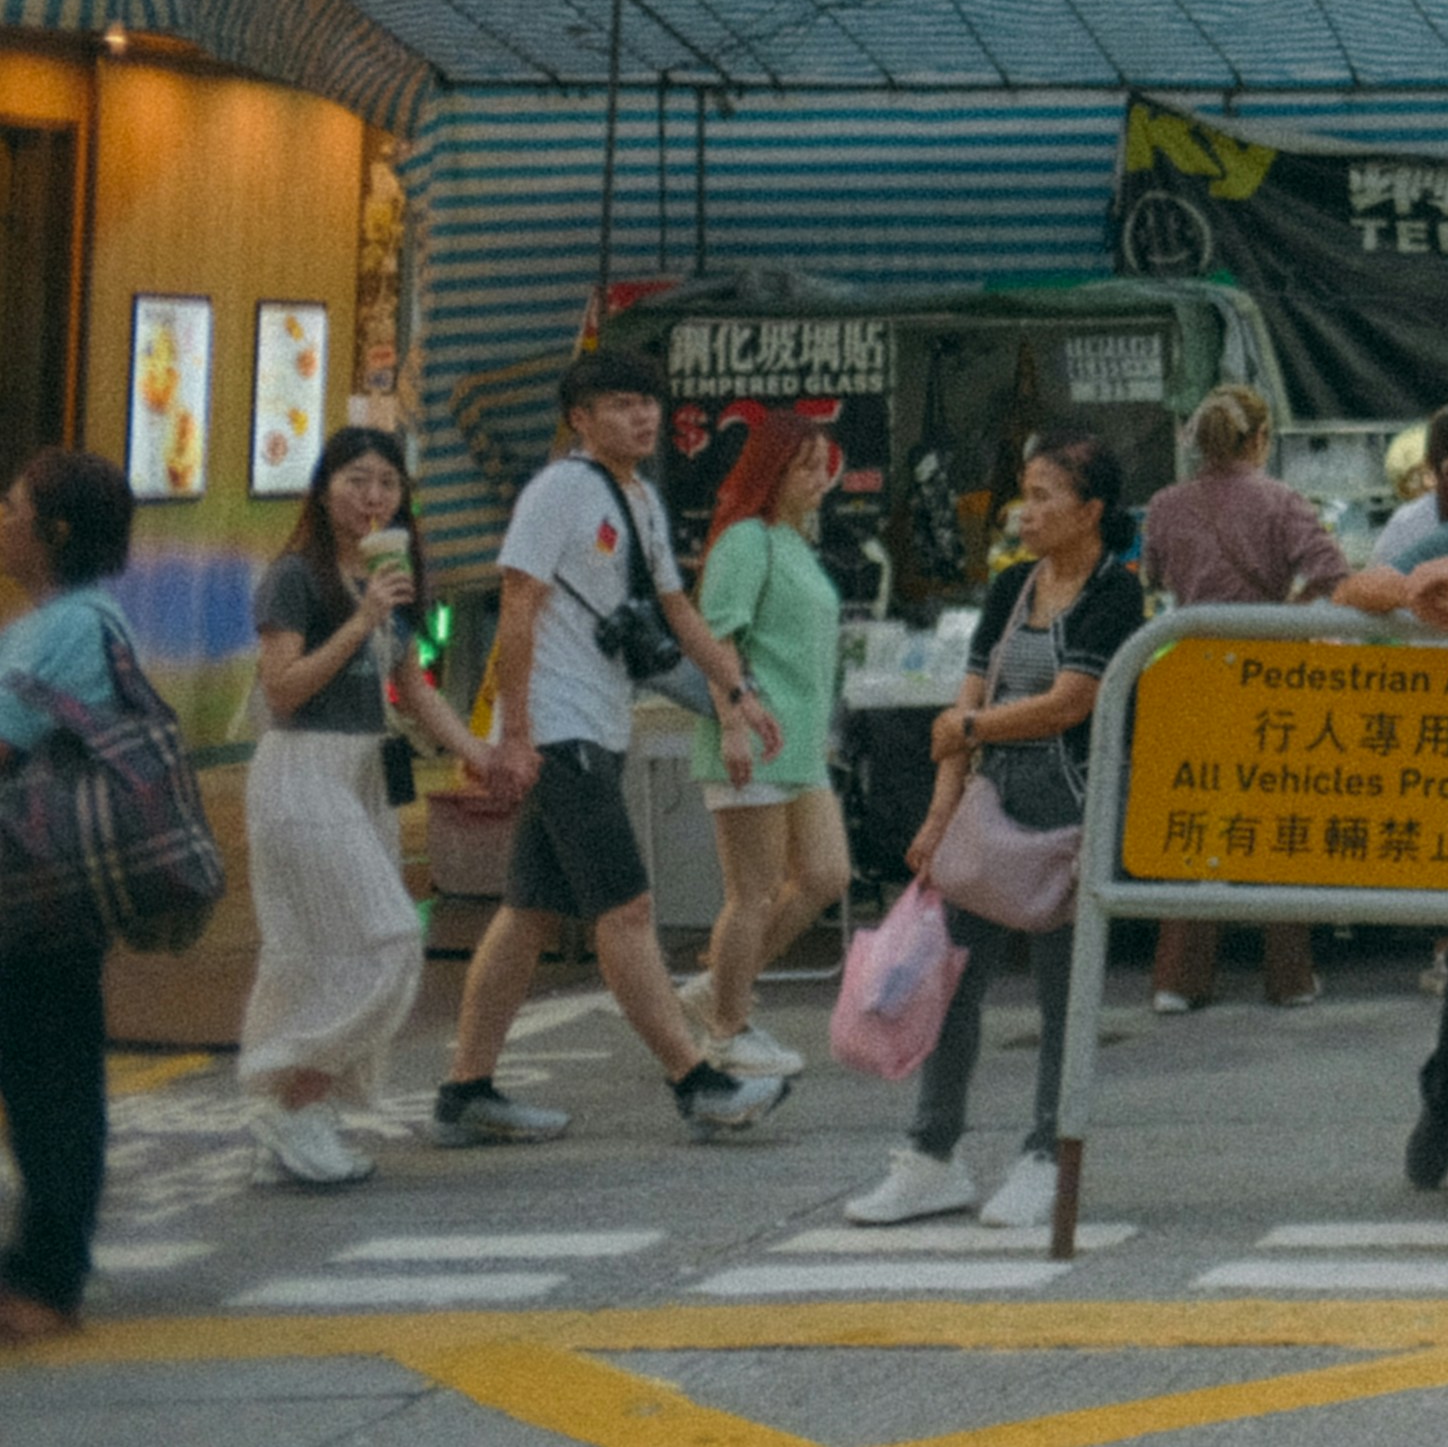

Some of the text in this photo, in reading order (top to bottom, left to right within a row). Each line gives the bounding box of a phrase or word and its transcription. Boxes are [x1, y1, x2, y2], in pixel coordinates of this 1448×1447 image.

[669, 373, 884, 398] TEMPERED GLASS
[1240, 657, 1430, 693] Pedestrian
[1172, 759, 1221, 792] All
[1236, 761, 1384, 797] Vehicles
